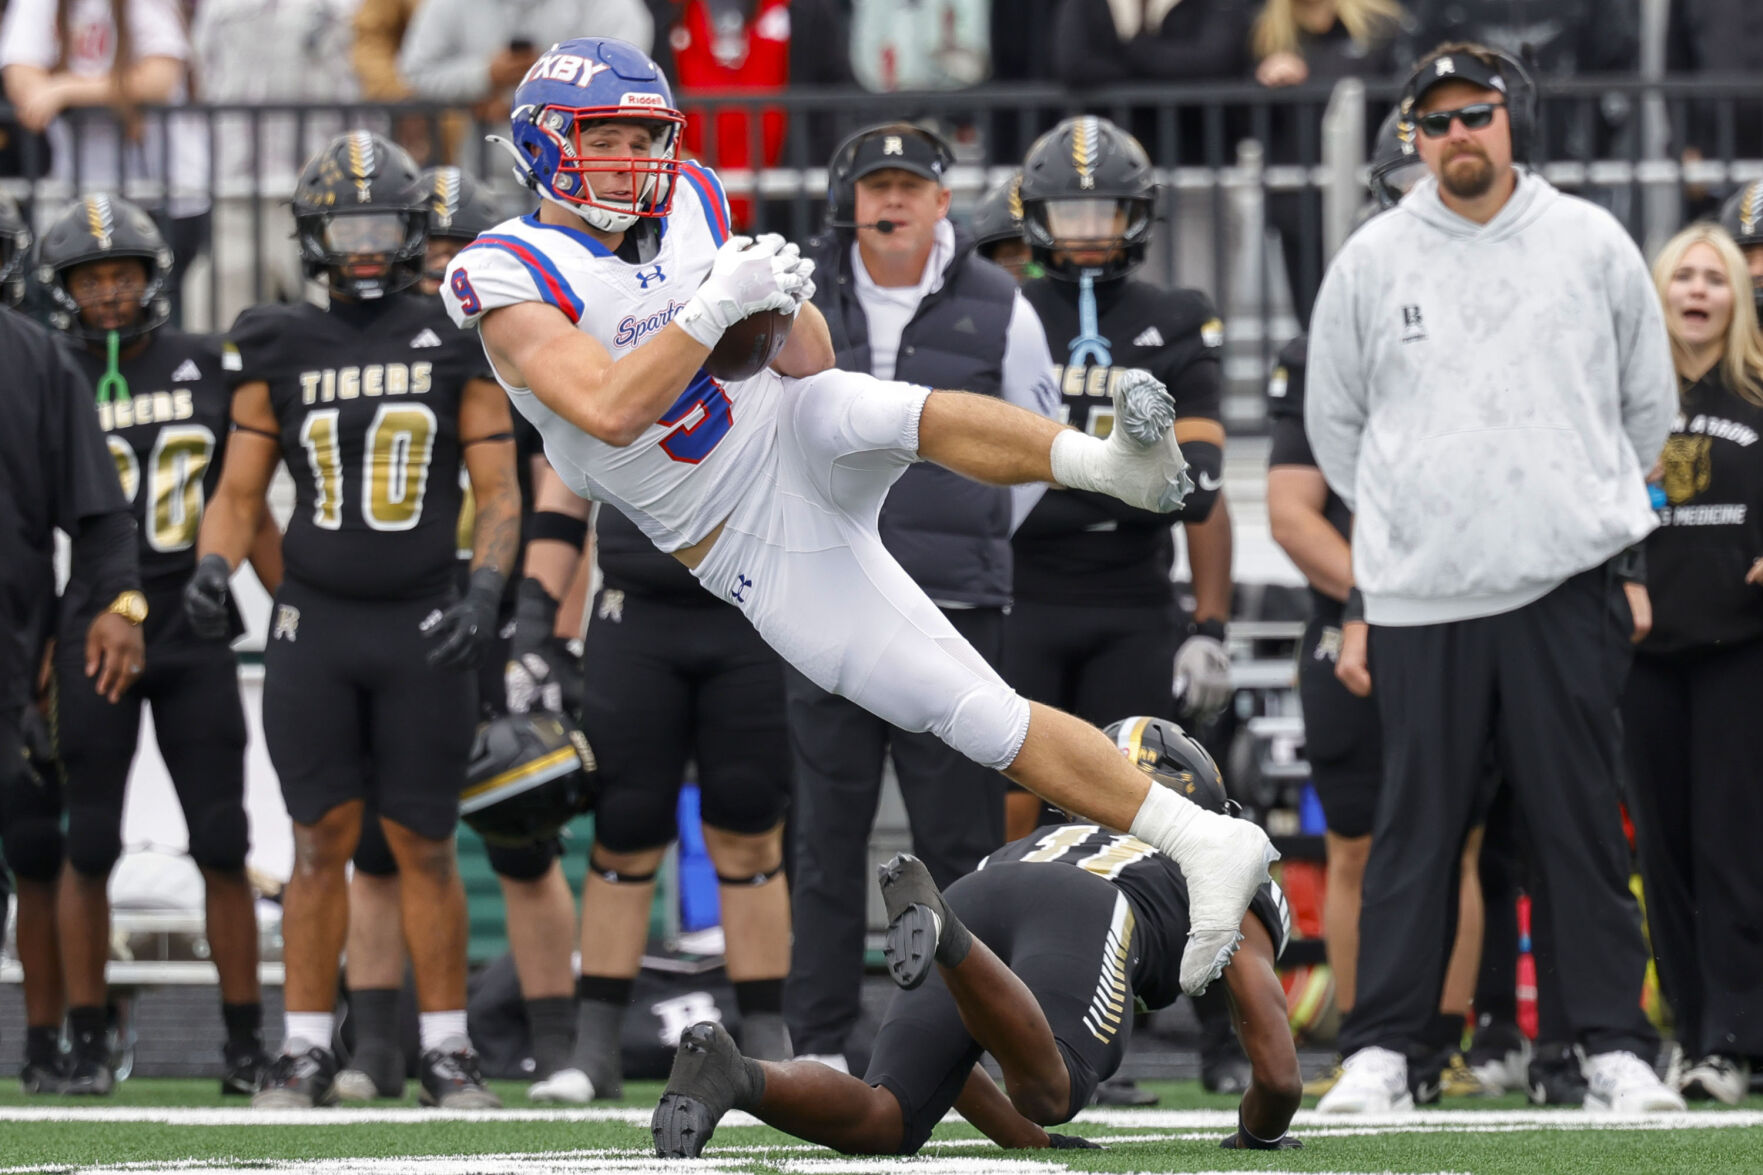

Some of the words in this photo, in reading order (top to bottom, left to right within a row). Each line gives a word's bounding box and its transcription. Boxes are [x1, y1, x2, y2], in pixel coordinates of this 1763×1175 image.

[627, 95, 662, 105] Riddell
[450, 266, 483, 317] 9
[300, 361, 433, 405] TIGERS
[96, 387, 194, 432] IGERS
[299, 402, 438, 532] 10
[1672, 504, 1747, 526] MEDICINE
